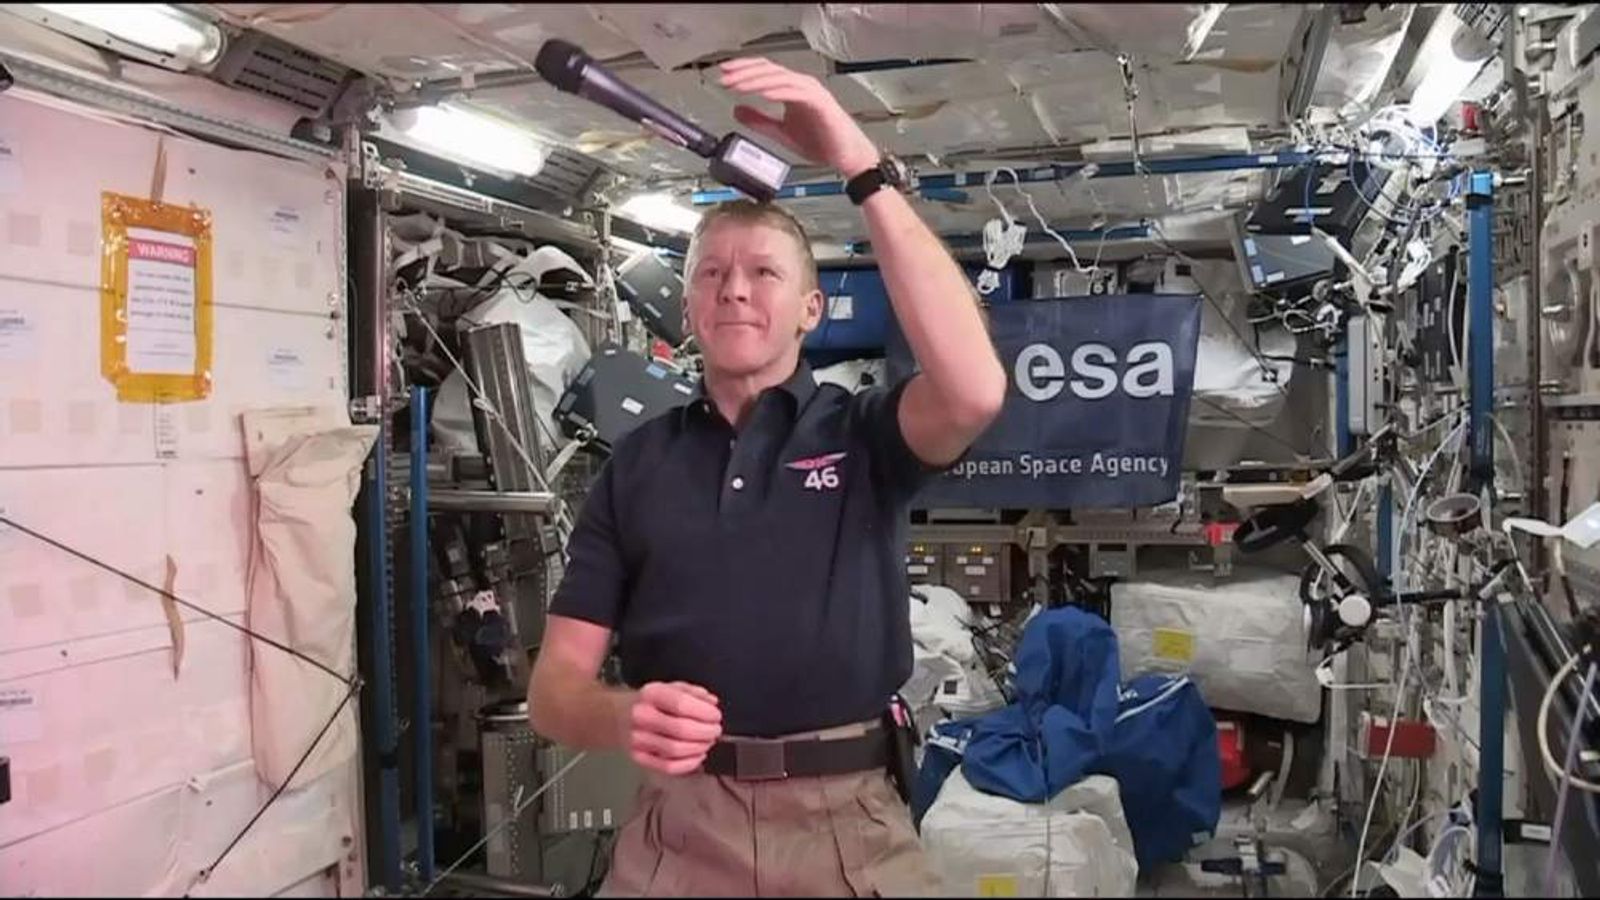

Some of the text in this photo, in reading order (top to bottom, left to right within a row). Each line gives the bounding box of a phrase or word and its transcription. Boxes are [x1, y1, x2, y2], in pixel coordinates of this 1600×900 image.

[136, 242, 190, 263] WARNING
[1014, 340, 1175, 402] esa
[804, 466, 839, 490] 46
[945, 452, 1168, 479] opean Space Agency
